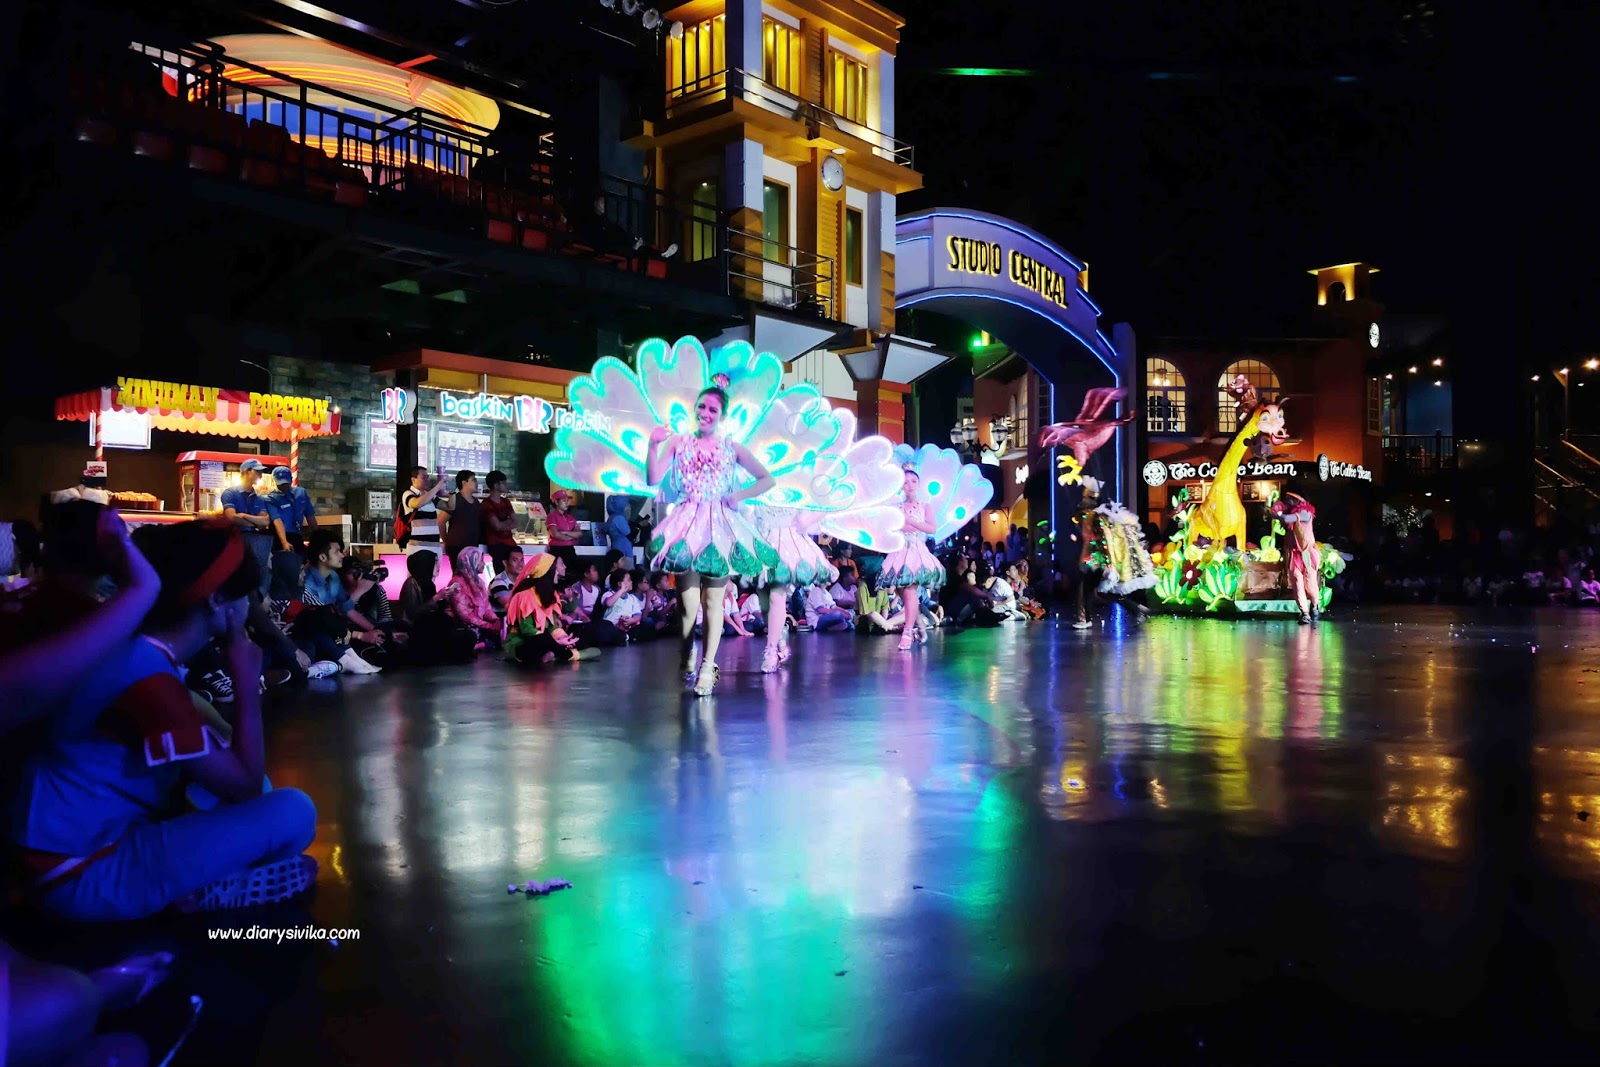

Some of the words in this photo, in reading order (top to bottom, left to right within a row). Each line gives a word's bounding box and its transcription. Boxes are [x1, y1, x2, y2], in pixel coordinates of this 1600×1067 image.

[946, 235, 1002, 277] STUDIO
[1008, 249, 1069, 309] CENTRAL
[117, 377, 219, 414] MINUMAN
[250, 392, 328, 425] POPCORN
[381, 388, 407, 424] BR
[440, 392, 513, 421] baskin
[514, 396, 553, 433] BR
[1168, 462, 1197, 481] The
[1198, 461, 1247, 478] Coe
[1248, 461, 1297, 477] Bean
[1329, 461, 1340, 477] The
[1340, 462, 1356, 478] Coffee
